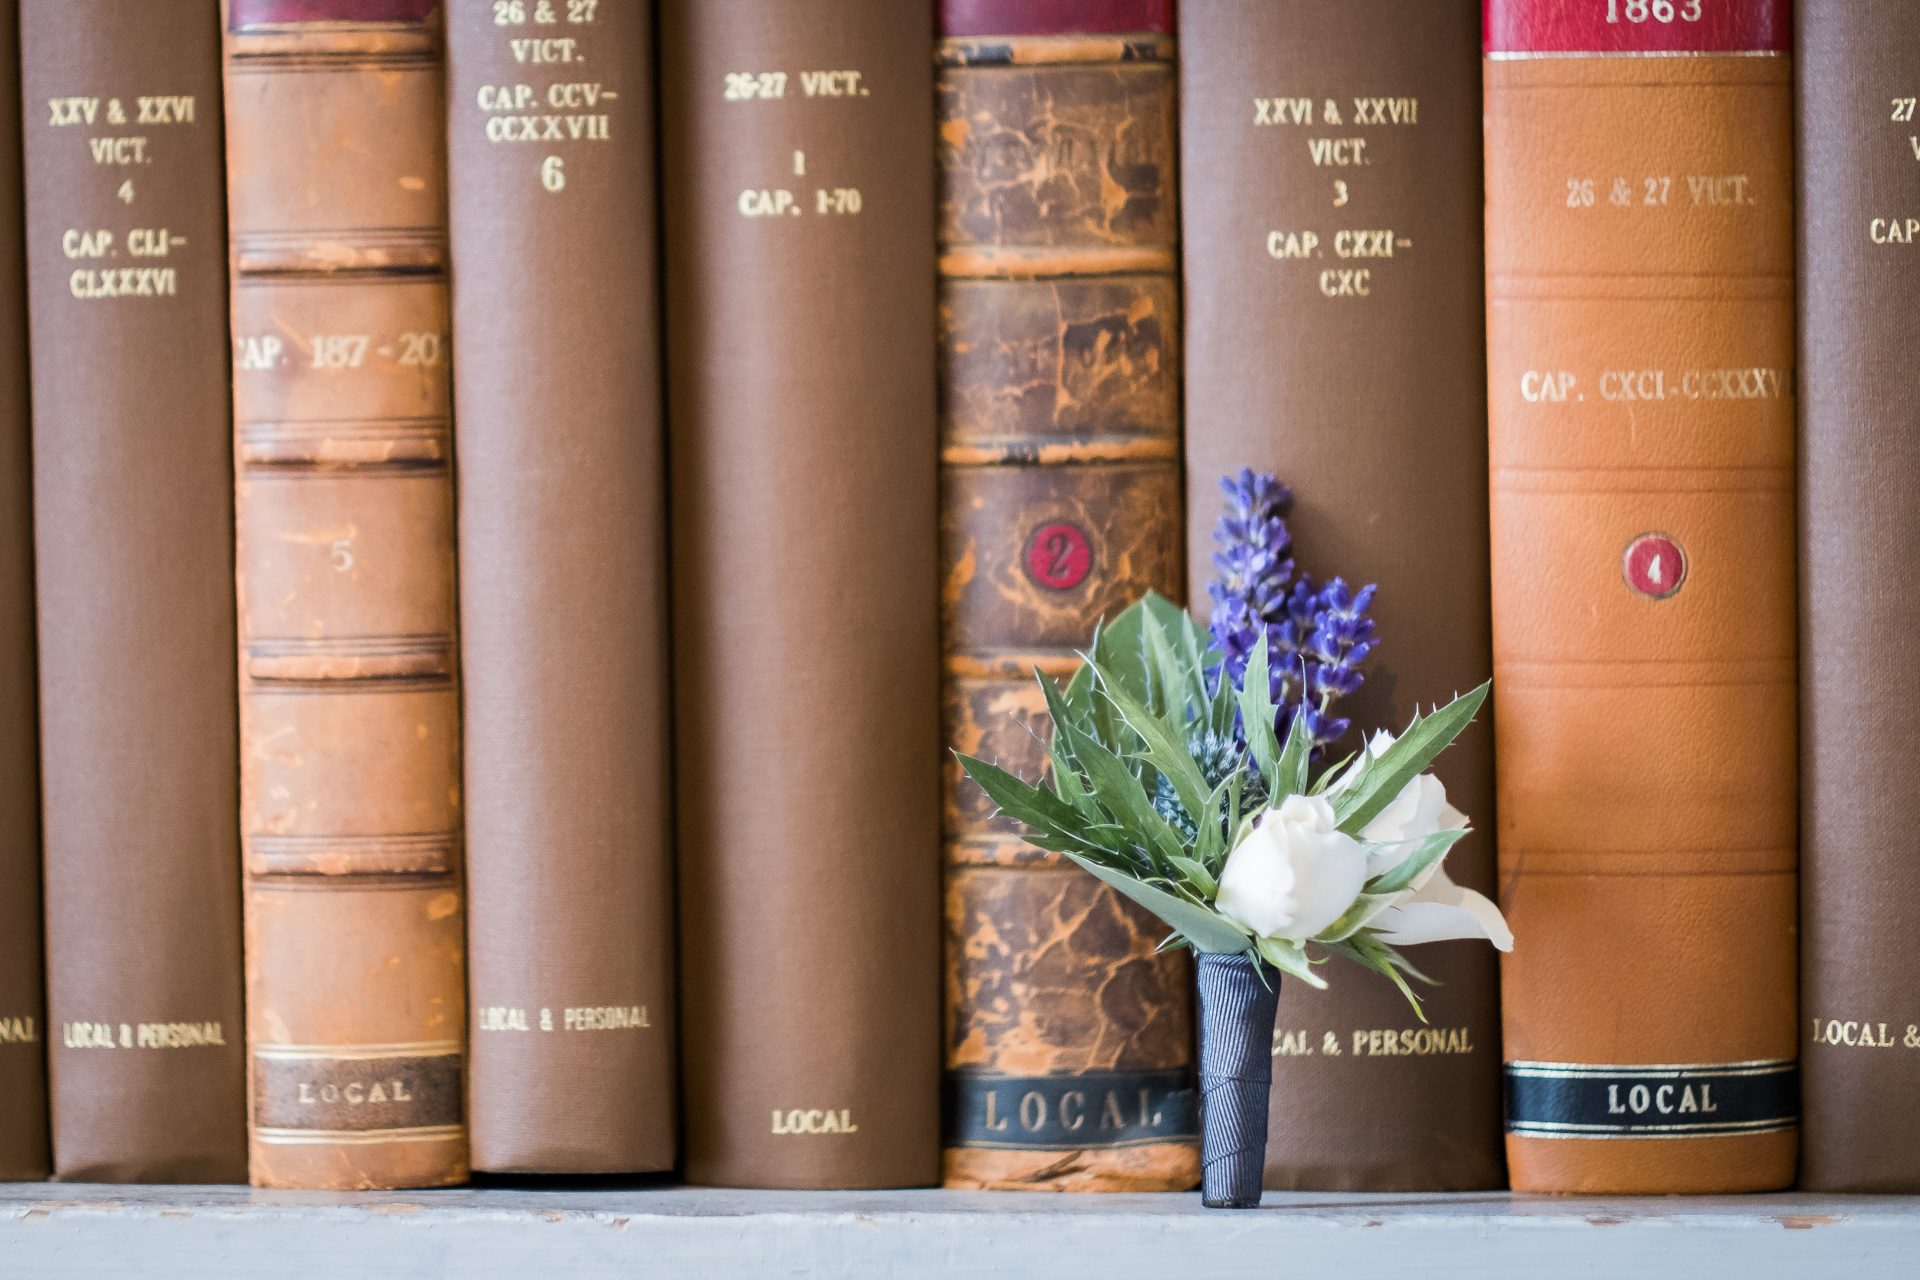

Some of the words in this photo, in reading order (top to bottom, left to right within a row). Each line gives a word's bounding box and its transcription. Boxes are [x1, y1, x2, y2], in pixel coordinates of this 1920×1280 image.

[493, 0, 526, 25] 26
[534, 0, 557, 24] &
[566, 0, 598, 23] 27
[1606, 0, 1702, 24] 1863
[510, 37, 585, 63] VICT.
[478, 83, 539, 111] CAP.
[548, 82, 619, 108] CCV-
[723, 71, 788, 100] 26-27
[800, 70, 870, 97] VICT.
[49, 96, 99, 126] XXV
[106, 97, 127, 124] &
[137, 95, 196, 125] XXVI
[1254, 97, 1313, 126] XXVI
[1323, 98, 1343, 125] &
[1353, 97, 1419, 125] XXVII
[1891, 97, 1917, 122] 27
[485, 114, 611, 143] CCXXVII
[90, 136, 152, 165] VICT.
[1308, 138, 1371, 167] VICT.
[541, 155, 567, 193] 6
[117, 179, 136, 205] 4
[738, 189, 801, 218] CAP.
[1333, 180, 1349, 208] 3
[1566, 176, 1595, 208] 26
[1609, 176, 1632, 207] &
[1643, 176, 1671, 206] 27
[1686, 174, 1755, 206] VICT.
[62, 228, 117, 259] CAP.
[127, 227, 188, 257] CLI-
[1267, 230, 1323, 260] CAP.
[1334, 229, 1413, 258] CXXI-
[1869, 217, 1920, 244] CAP
[70, 267, 177, 299] CLXXXVI
[1319, 268, 1371, 297] CXC
[236, 335, 288, 370] AP.
[1520, 369, 1585, 402] CAP.
[332, 538, 354, 574] 5
[1046, 532, 1073, 578] 2
[479, 1006, 531, 1032] LOCAL
[540, 1006, 554, 1032] &
[564, 1004, 652, 1031] PERSONAL
[1812, 1017, 1895, 1048] LOCAL
[1903, 1023, 1920, 1048] &
[1272, 1028, 1314, 1057] CAL
[1322, 1030, 1343, 1057] &
[1352, 1026, 1475, 1057] PERSONAL
[298, 1081, 413, 1105] LOCAL
[1608, 1083, 1718, 1115] LOCAL
[771, 1108, 858, 1136] LOCAL
[985, 1088, 1162, 1133] LOCAL
